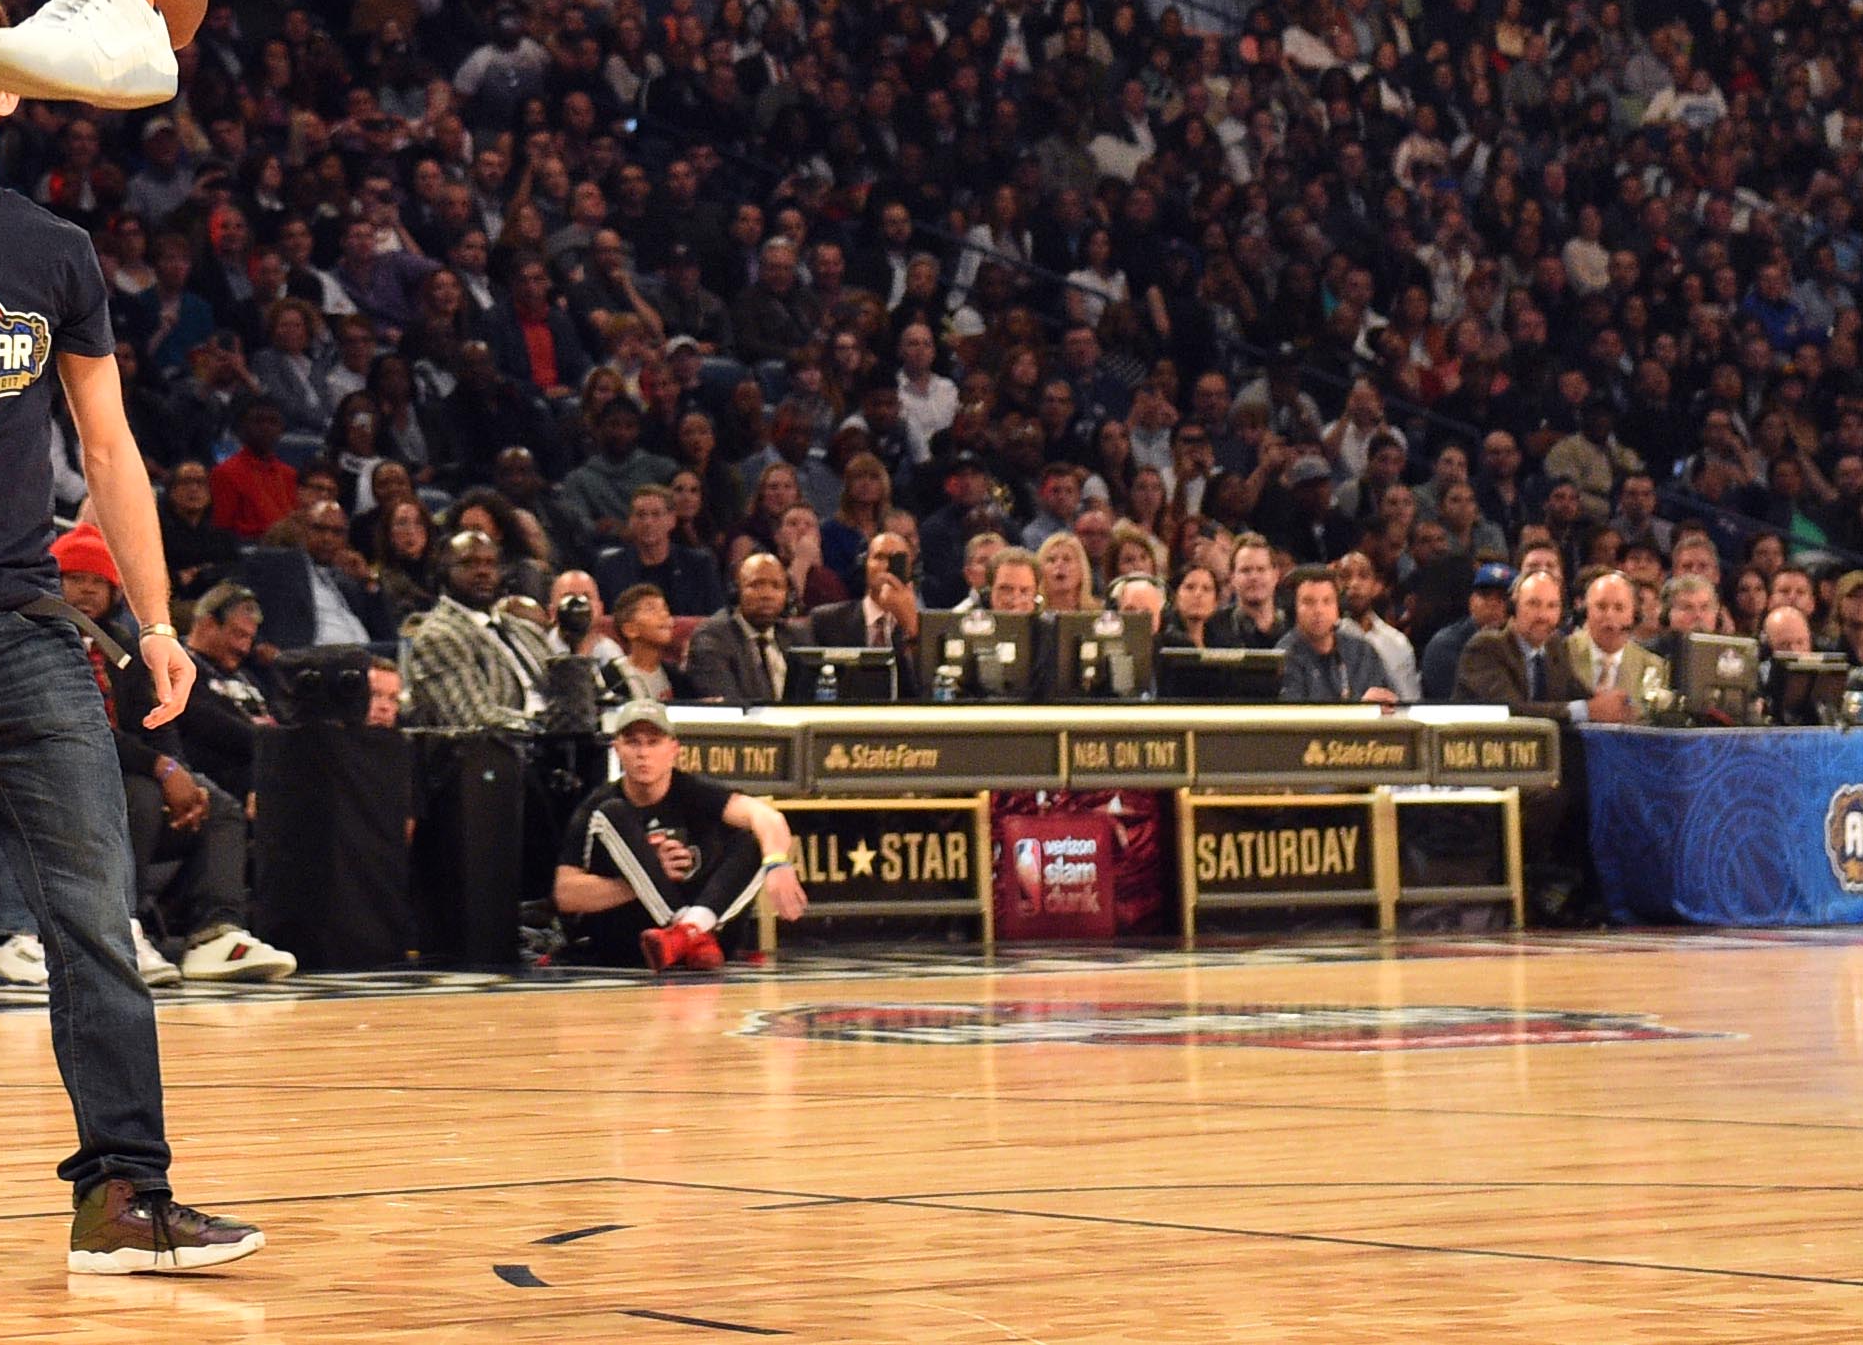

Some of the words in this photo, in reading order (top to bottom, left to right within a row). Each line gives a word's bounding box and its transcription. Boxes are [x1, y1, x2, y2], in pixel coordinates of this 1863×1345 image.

[676, 745, 703, 772] BA
[709, 745, 736, 772] ON
[743, 746, 778, 772] TNT
[1073, 742, 1109, 768] NBA
[1114, 742, 1138, 768] ON
[1144, 741, 1177, 768] TNT
[1443, 741, 1477, 768] NBA
[1482, 741, 1505, 767] ON
[1510, 740, 1539, 767] TNT
[792, 833, 847, 882] ALL
[880, 832, 969, 881] STAR
[1042, 835, 1097, 856] verizon
[1196, 826, 1360, 881] SATURDAY
[1043, 856, 1097, 885] slam
